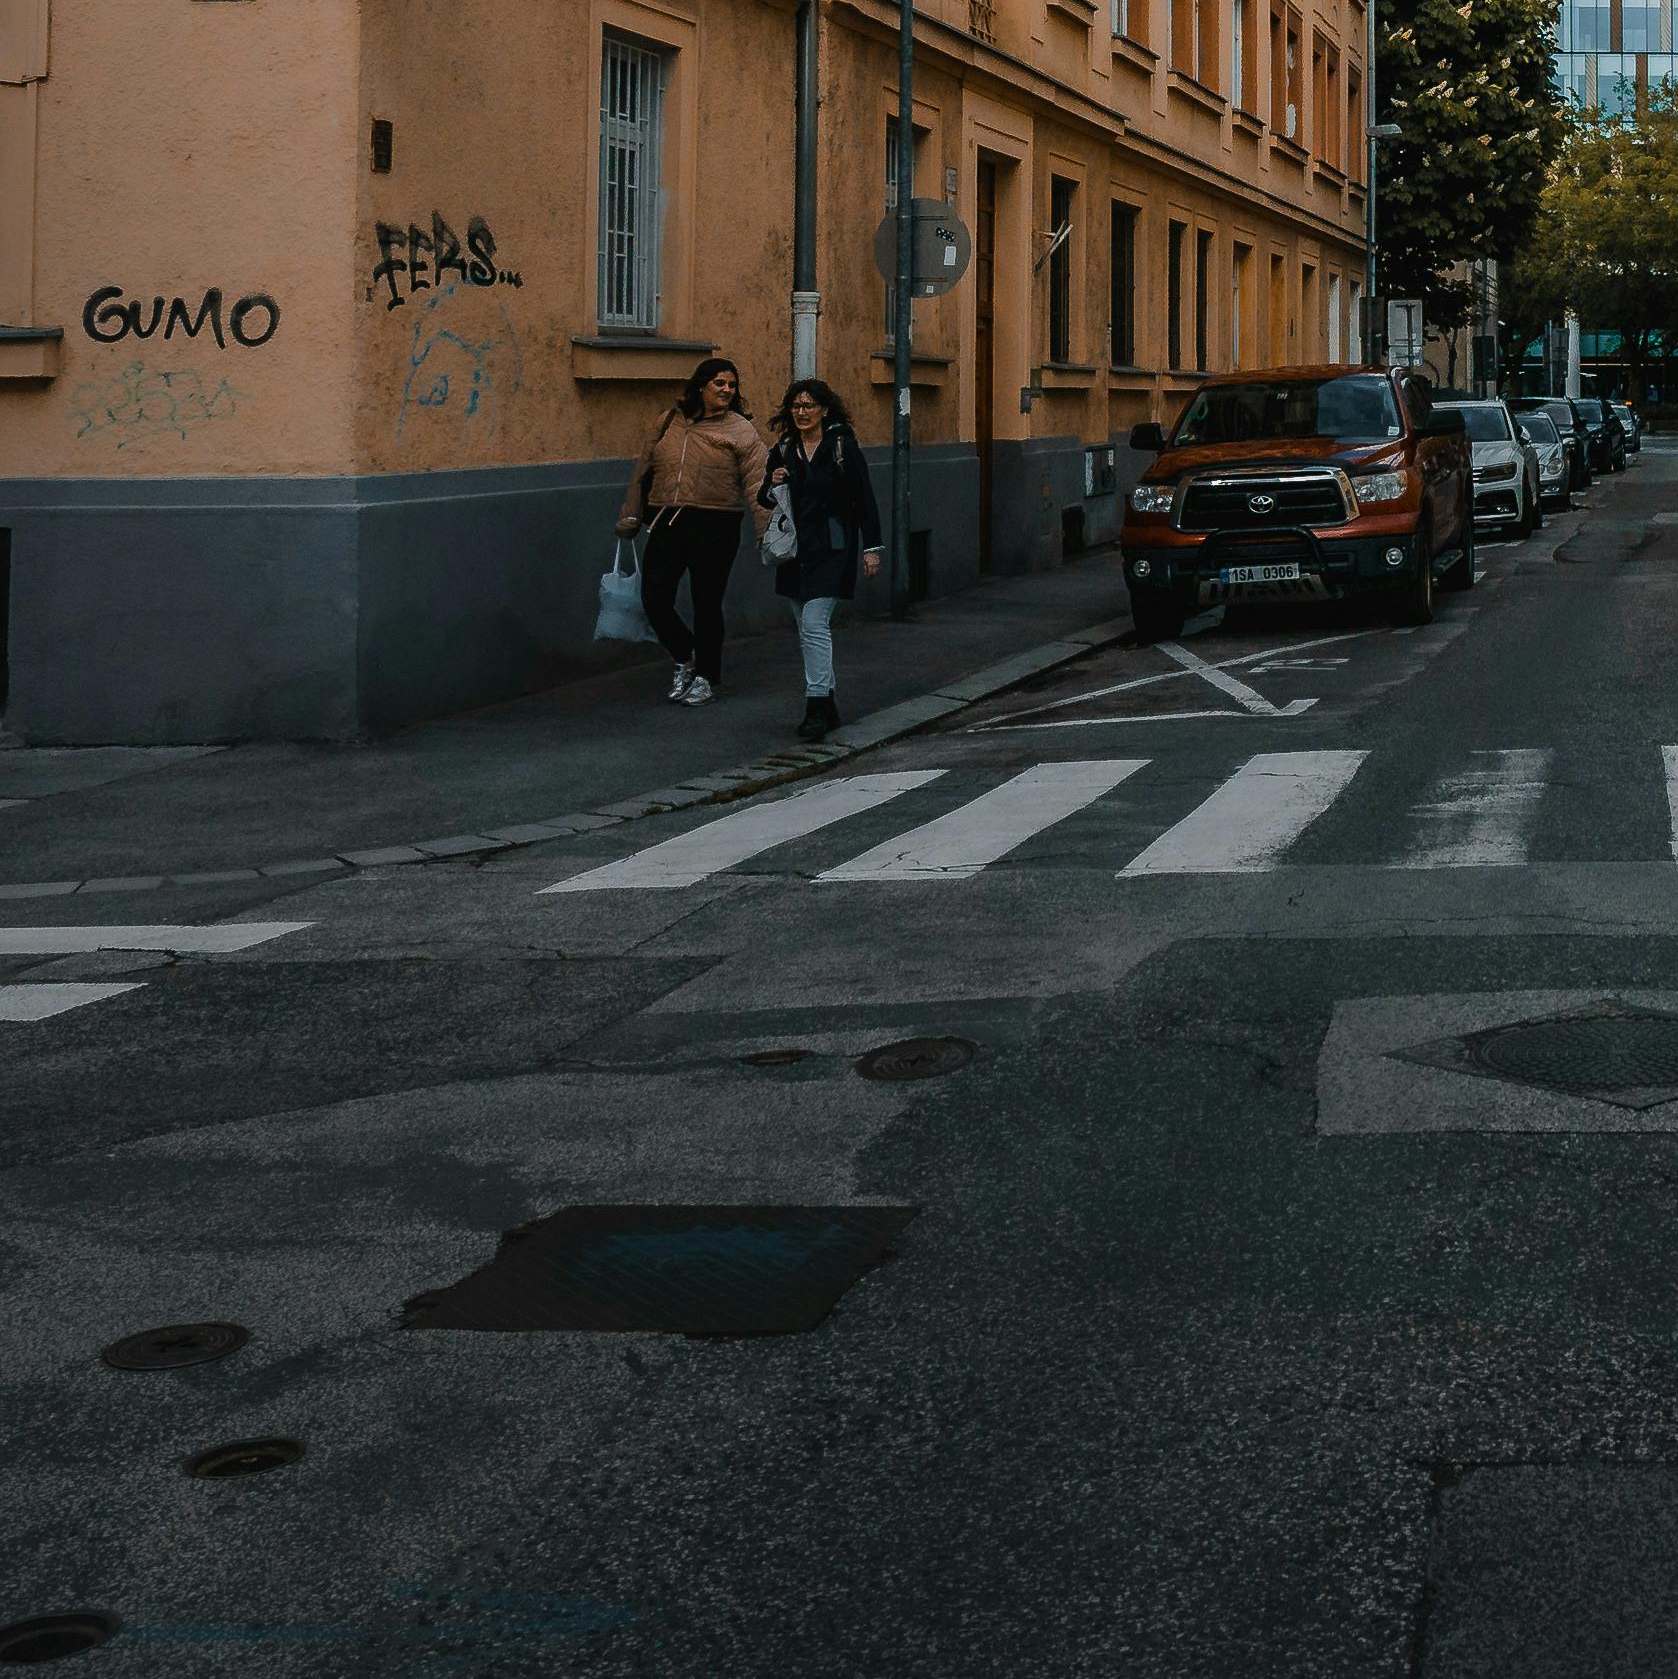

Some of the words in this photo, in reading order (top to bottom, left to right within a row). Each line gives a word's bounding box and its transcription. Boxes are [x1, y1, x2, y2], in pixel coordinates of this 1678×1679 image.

[82, 285, 280, 349] GUMO
[1231, 568, 1255, 582] 1SA
[1262, 565, 1294, 580] 0306
